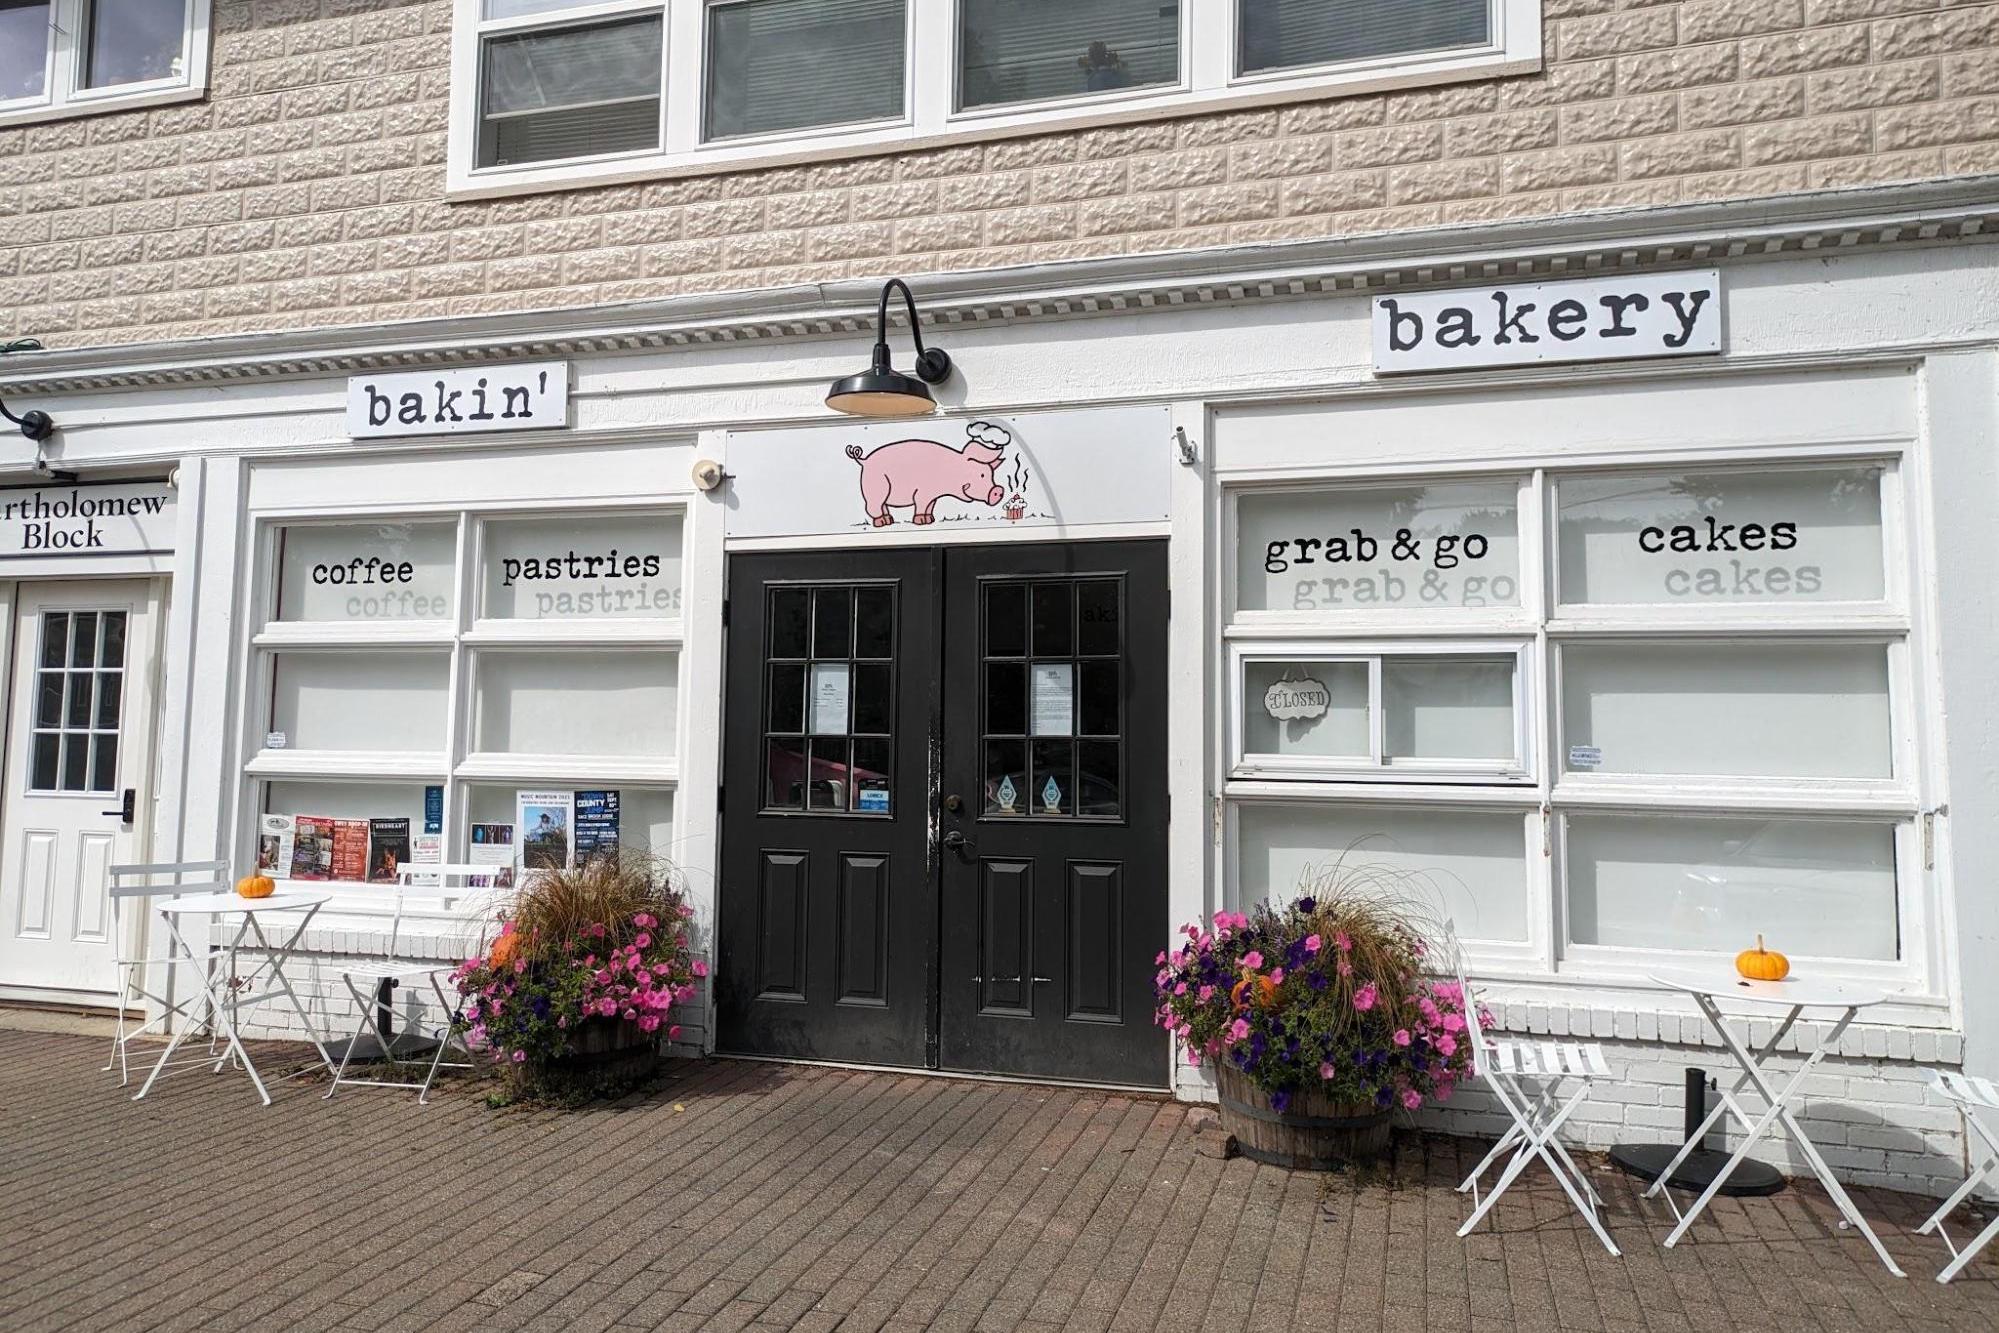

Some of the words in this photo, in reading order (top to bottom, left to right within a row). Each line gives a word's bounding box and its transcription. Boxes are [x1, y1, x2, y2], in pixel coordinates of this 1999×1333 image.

[1379, 289, 1711, 351] bakery
[364, 370, 548, 427] bakin'
[0, 489, 168, 521] rtholomew
[21, 518, 104, 550] Block
[1264, 528, 1378, 574] grab
[1390, 528, 1421, 561] &
[1433, 533, 1489, 569] go
[1638, 515, 1798, 553] cakes
[311, 557, 414, 585] coffee
[502, 549, 661, 586] pastries
[1664, 559, 1822, 597] cakes
[345, 589, 448, 618] coffee
[1293, 568, 1407, 610] grab
[1419, 568, 1449, 602] &
[1461, 574, 1516, 608] go
[1268, 689, 1325, 710] CLOSED
[576, 799, 605, 807] COUNTY
